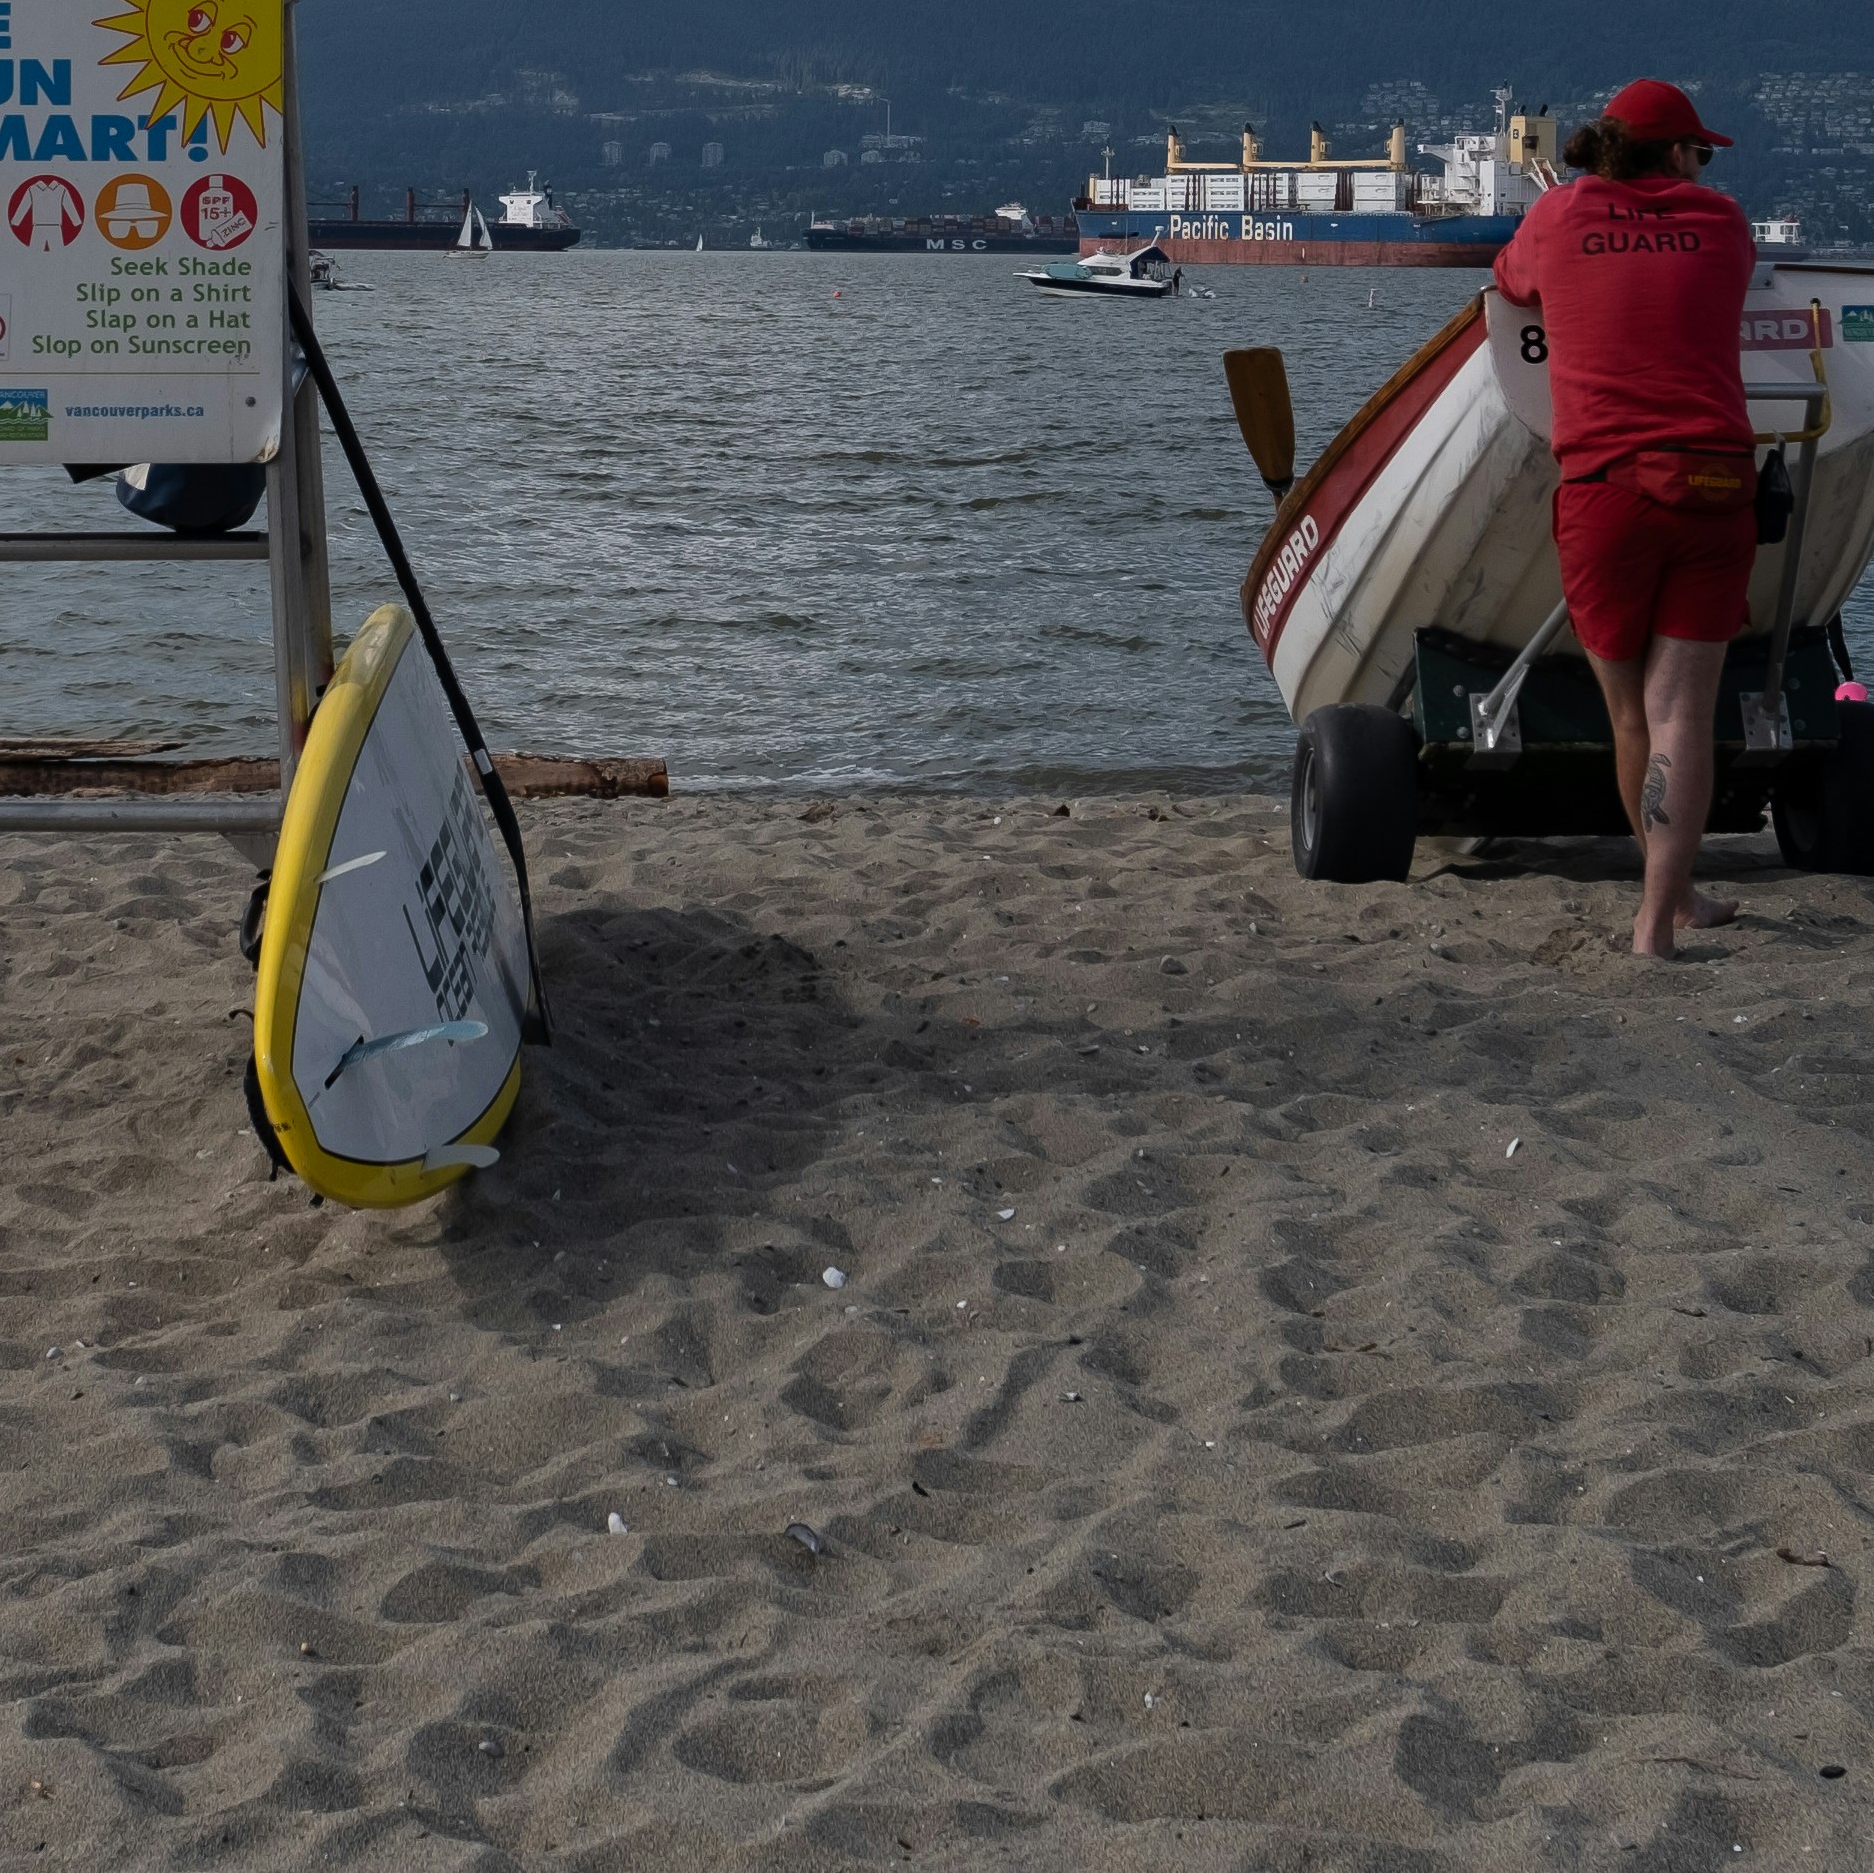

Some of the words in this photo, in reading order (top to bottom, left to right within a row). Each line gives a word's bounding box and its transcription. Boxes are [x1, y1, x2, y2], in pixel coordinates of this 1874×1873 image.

[201, 207, 231, 220] 15+
[1609, 202, 1677, 222] LIFE
[1169, 214, 1230, 241] Pacific
[1241, 215, 1294, 241] Basin
[926, 238, 988, 250] MSC
[1582, 231, 1701, 255] GUARD
[110, 257, 168, 277] Seek
[178, 257, 252, 277] Shade
[76, 283, 122, 307] Slip
[131, 288, 161, 303] on
[170, 288, 183, 303] a
[192, 283, 252, 303] Shirt
[86, 309, 136, 334] Slap
[147, 314, 176, 330] on
[185, 314, 198, 330] a
[209, 309, 251, 330] Hat
[32, 335, 81, 359] Slop
[90, 340, 119, 355] on
[128, 336, 252, 356] Sunscreen
[1520, 324, 1549, 365] 8
[65, 404, 205, 420] vancouverparks.ca
[1253, 514, 1319, 640] LIFEGUARD
